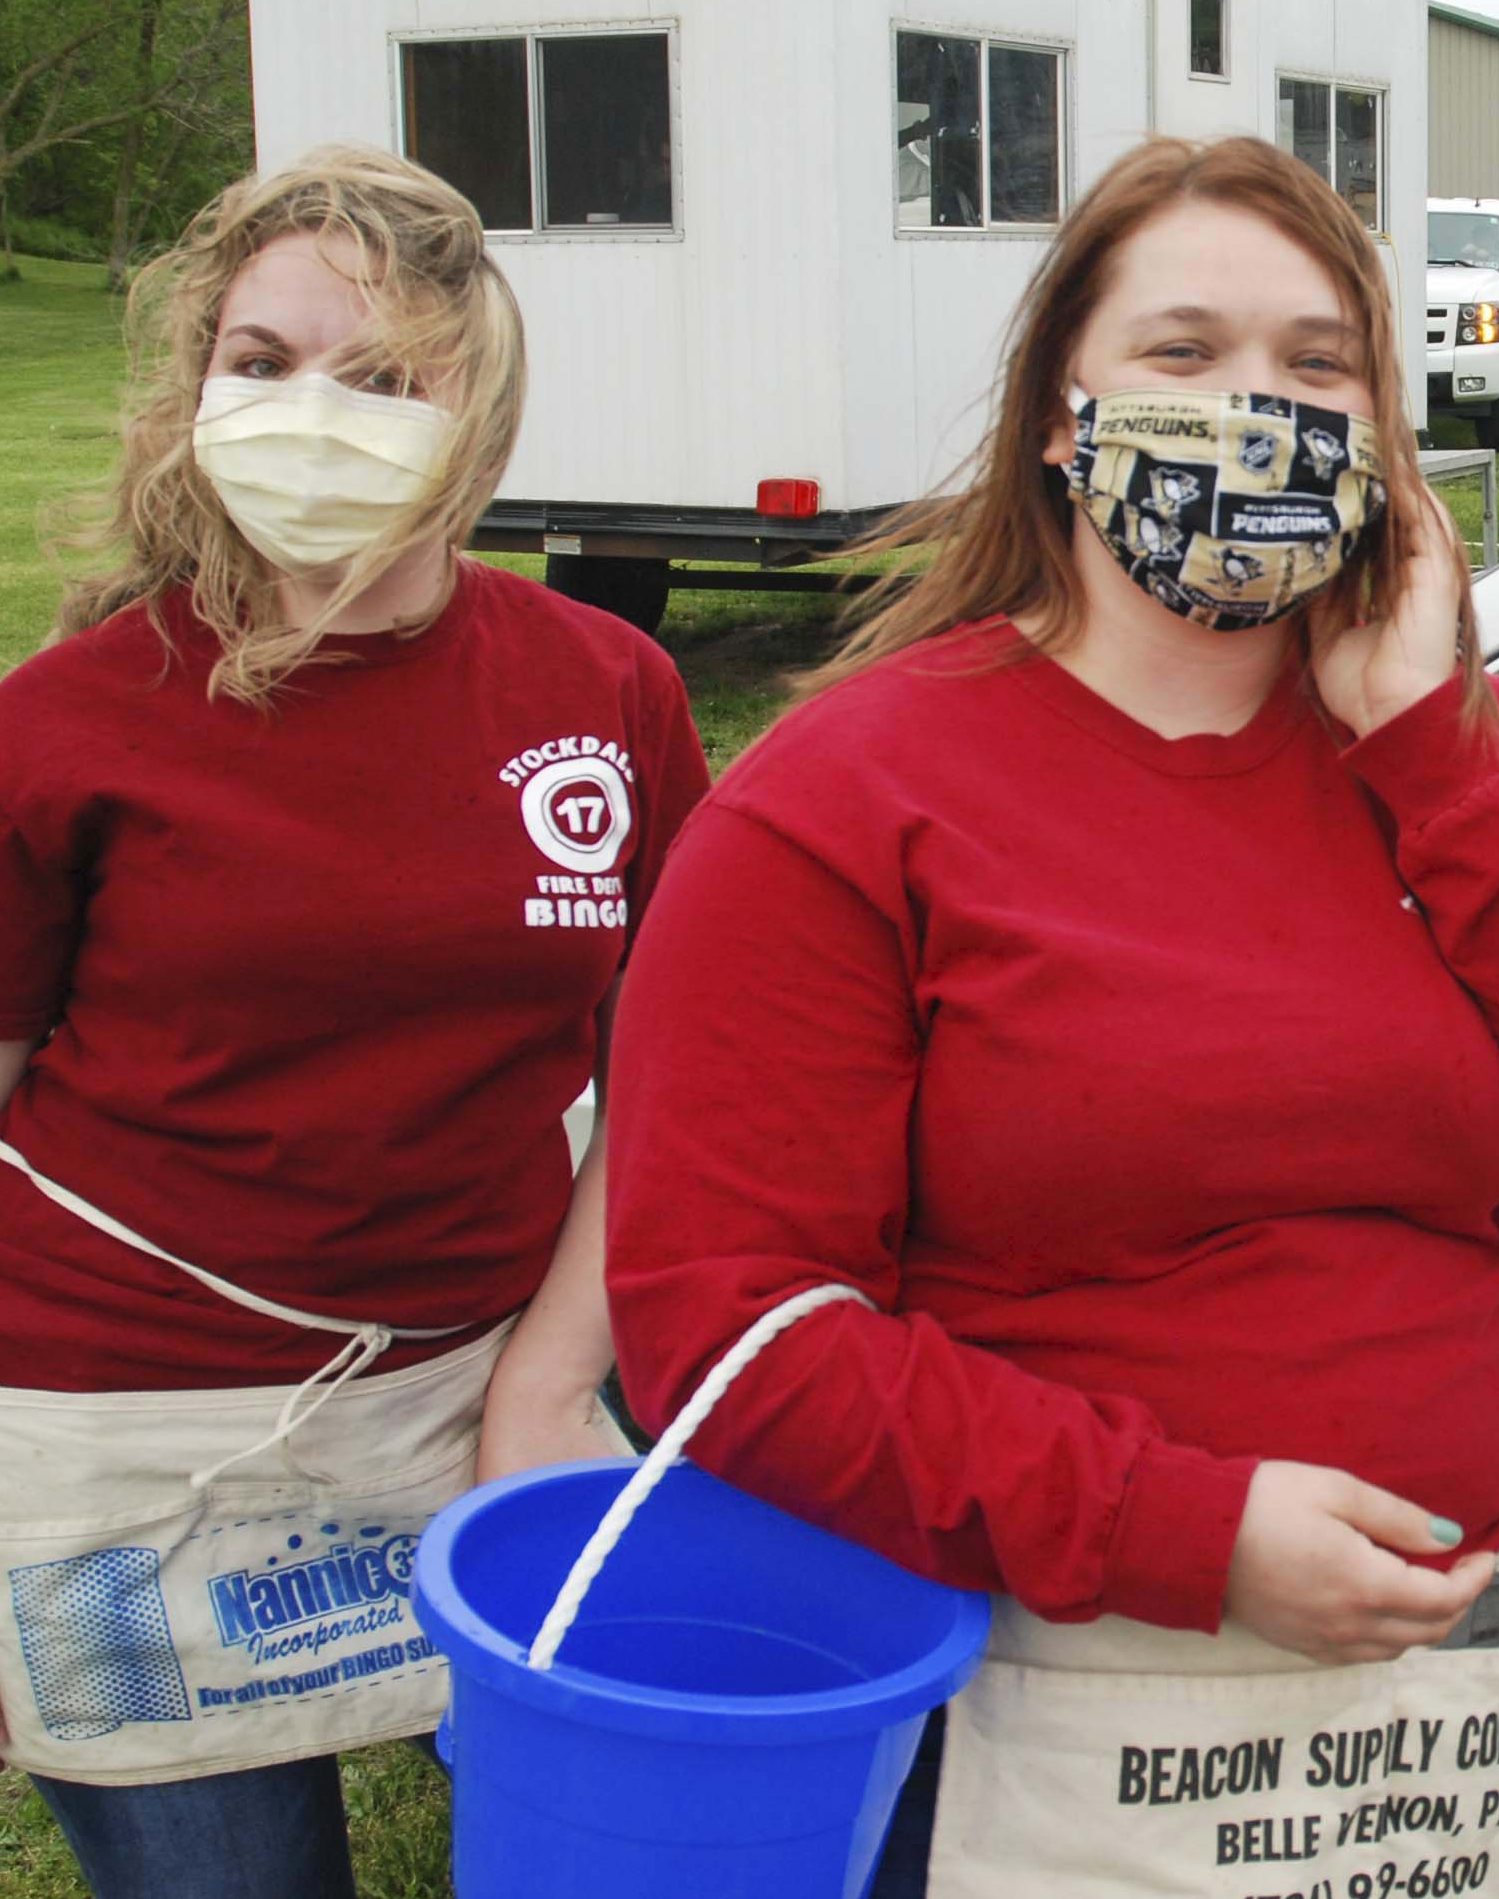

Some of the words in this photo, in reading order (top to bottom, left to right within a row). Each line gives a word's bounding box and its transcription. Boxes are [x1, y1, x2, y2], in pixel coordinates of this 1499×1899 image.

[1100, 418, 1209, 438] PENGUINS
[1232, 513, 1332, 534] PENGUINS
[556, 796, 605, 834] 17
[536, 875, 589, 894] FIRE
[248, 1599, 404, 1665] Incorporated
[338, 1641, 404, 1681] BINGO
[1117, 1736, 1285, 1806] BEACON
[1215, 1814, 1322, 1865] BELLE
